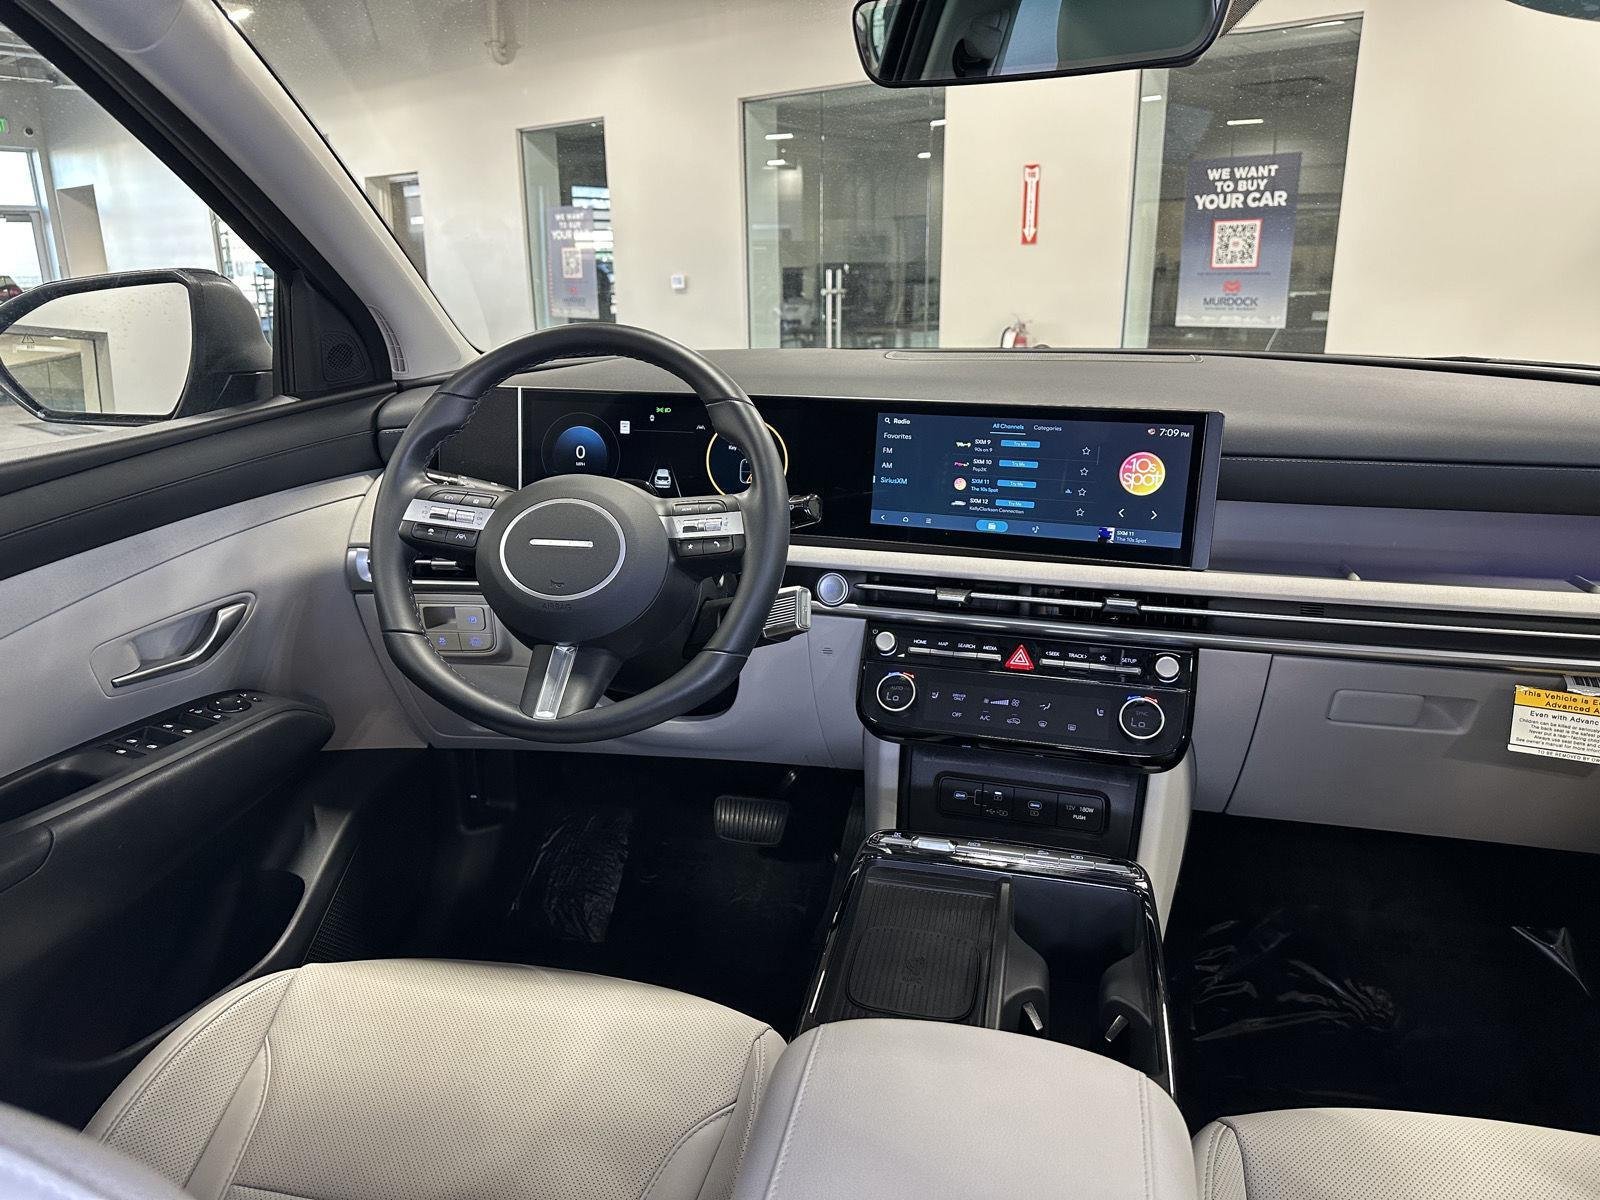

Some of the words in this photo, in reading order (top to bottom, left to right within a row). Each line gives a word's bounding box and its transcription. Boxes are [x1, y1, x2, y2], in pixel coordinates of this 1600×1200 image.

[1207, 168, 1231, 181] WE
[1234, 164, 1279, 178] WANT
[1214, 180, 1234, 193] TO
[1237, 178, 1268, 192] BUY
[1194, 193, 1244, 210] YOUR
[1247, 191, 1288, 207] CAR
[1203, 297, 1258, 306] MURDOCK
[1160, 428, 1180, 437] 7:09
[576, 445, 585, 459] 0
[880, 477, 908, 485] SiriusXM
[1124, 472, 1162, 490] spot
[1545, 692, 1578, 702] Vehicle
[1545, 701, 1590, 712] Advanced
[1552, 713, 1567, 721] with
